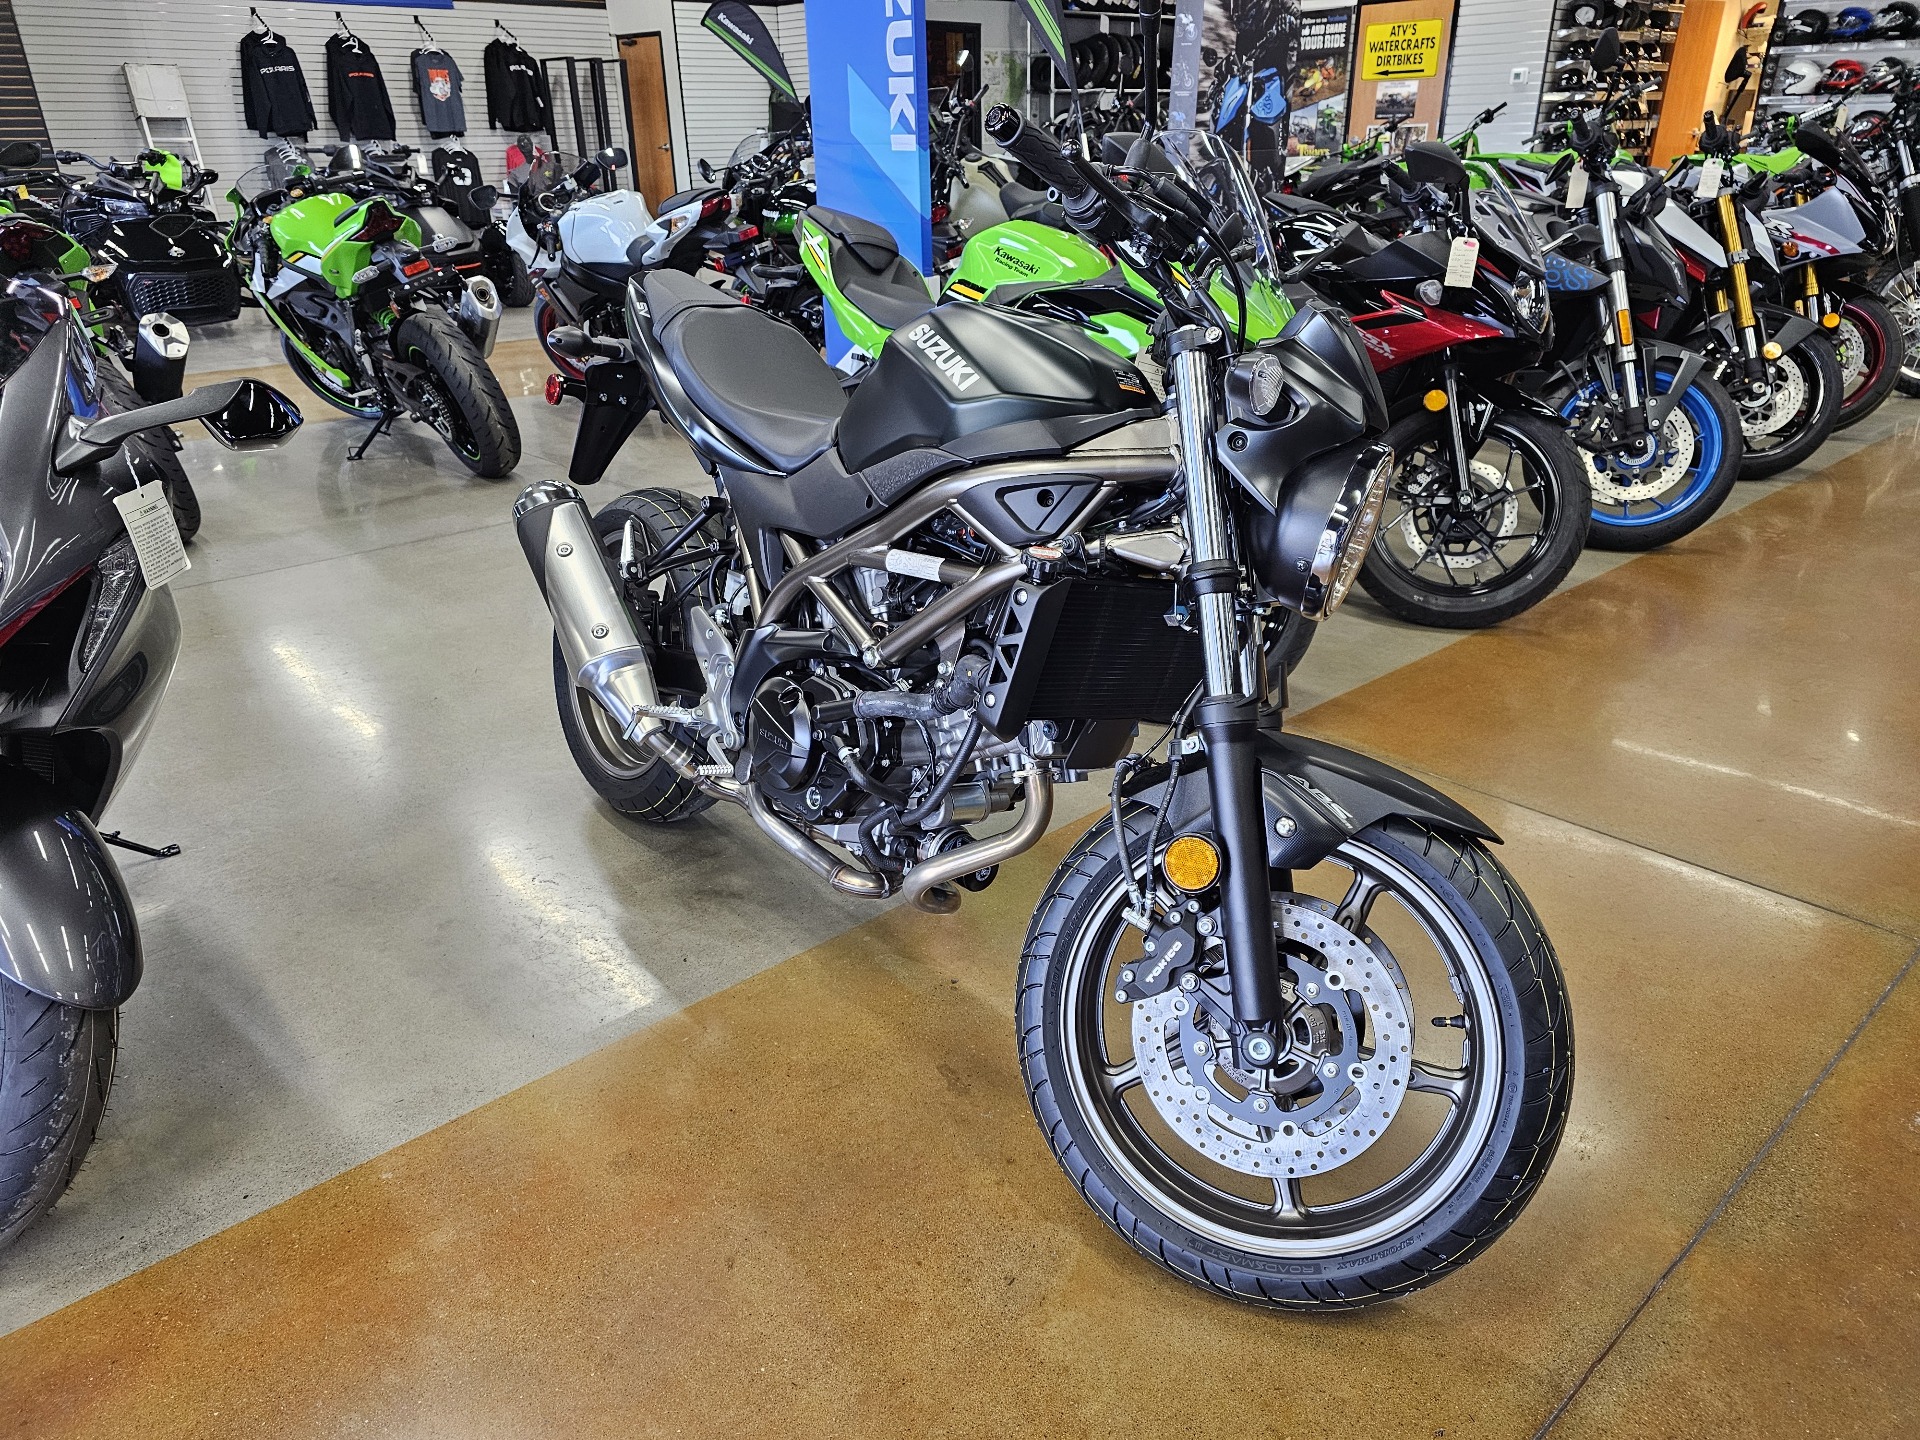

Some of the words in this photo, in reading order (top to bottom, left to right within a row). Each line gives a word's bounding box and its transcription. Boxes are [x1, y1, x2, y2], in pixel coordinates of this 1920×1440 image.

[717, 12, 755, 45] Kawasaki
[1311, 25, 1325, 35] AND
[1326, 22, 1347, 34] SHARE
[1390, 23, 1418, 37] ATV'S
[1300, 36, 1324, 50] YOUR
[1324, 34, 1346, 49] RIDE
[1369, 36, 1436, 53] WATERCRAFTS
[260, 65, 296, 75] POLARIS
[1376, 52, 1424, 67] DIRTBIKES
[1302, 230, 1329, 251] SUZ
[993, 246, 1041, 275] Kawasaki
[994, 257, 1013, 270] Racing
[1013, 266, 1029, 278] Team
[908, 323, 981, 392] SUZUKI
[760, 728, 788, 751] SUZUKI
[1145, 941, 1183, 983] TOKICO
[1206, 1249, 1315, 1275] ROADSMART
[1336, 1235, 1416, 1271] SPORTMAX
